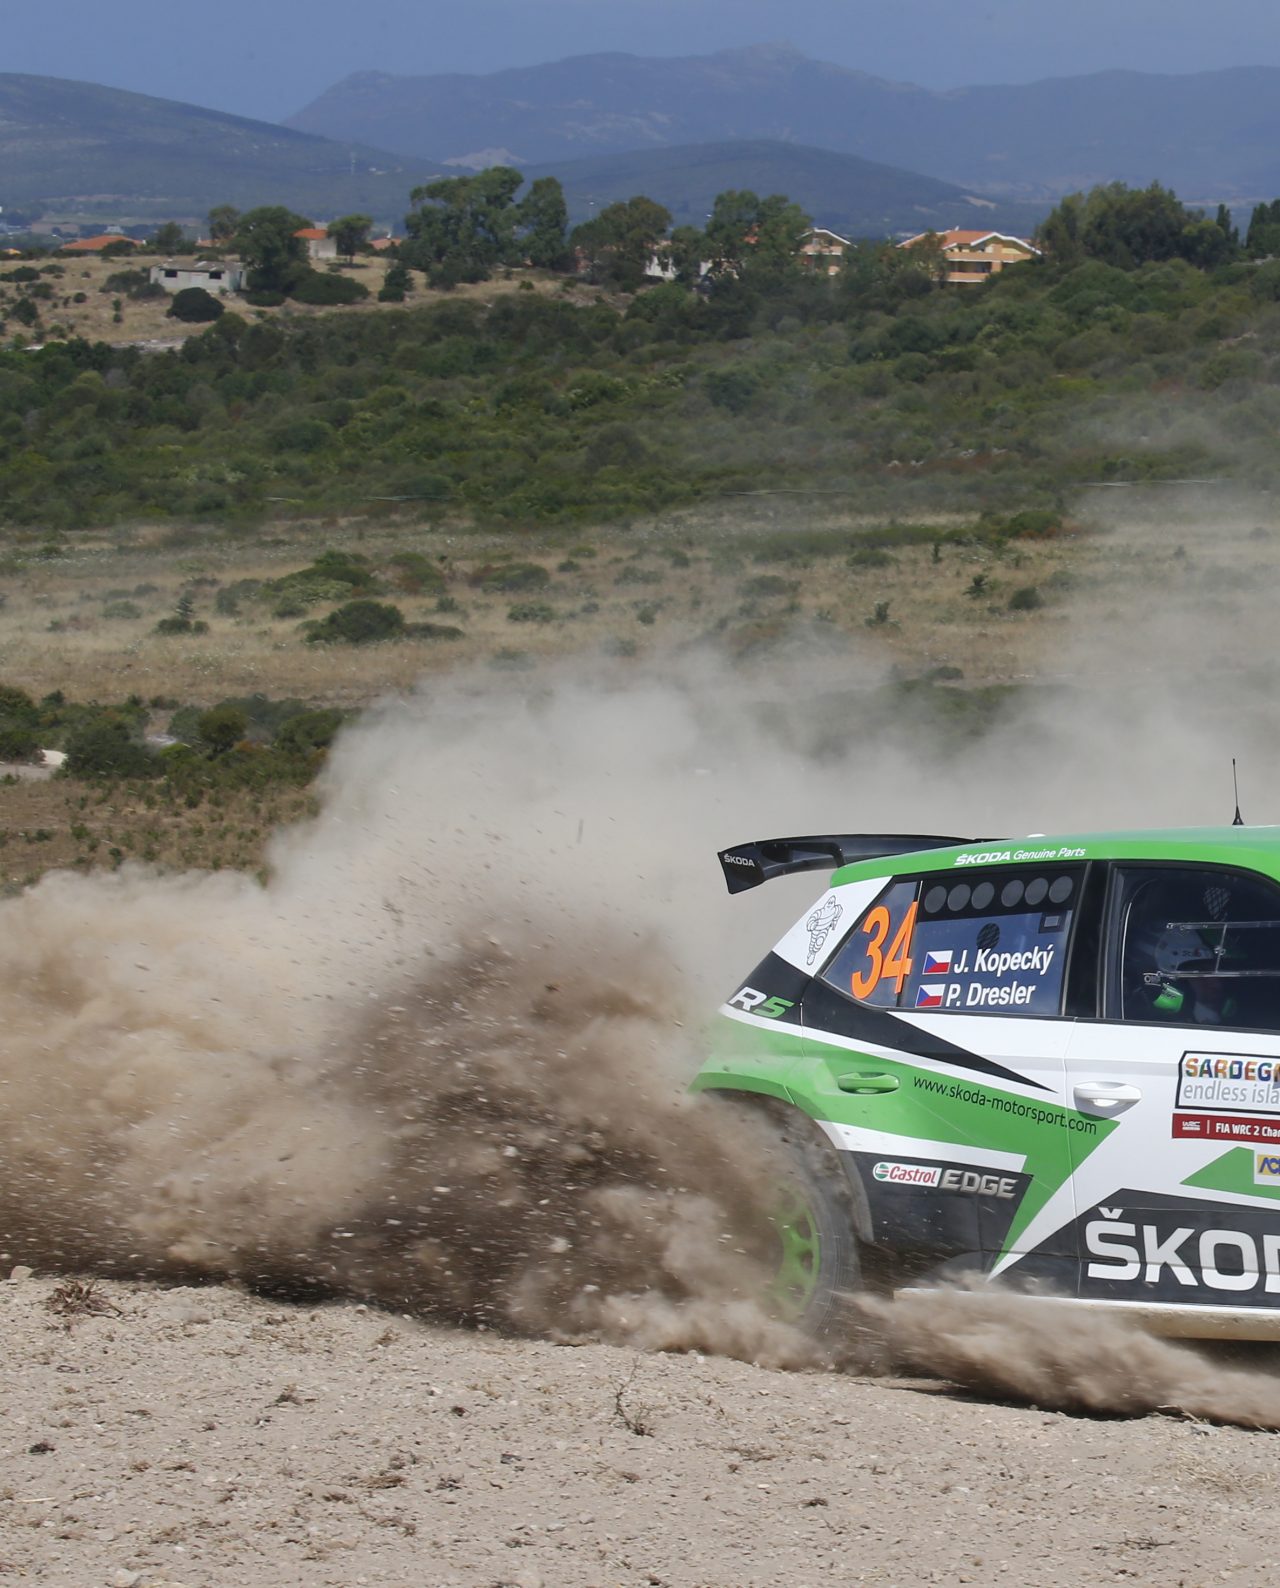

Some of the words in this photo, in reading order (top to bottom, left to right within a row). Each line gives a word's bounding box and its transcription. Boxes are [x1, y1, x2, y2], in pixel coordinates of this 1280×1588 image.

[954, 852, 1011, 866] ŠKODA
[1013, 849, 1056, 860] Genuine
[1057, 847, 1087, 858] Parts
[851, 901, 919, 1000] 34
[954, 949, 969, 974] J.
[974, 944, 1055, 977] Kopecký
[728, 985, 797, 1019] R5
[945, 983, 961, 1007] P.
[966, 981, 1036, 1006] Dresler
[914, 1075, 1097, 1135] www.skoda-motorsport.com
[1184, 1080, 1247, 1103] endless
[1216, 1122, 1230, 1133] FIA
[1232, 1123, 1251, 1135] WRC
[1253, 1125, 1260, 1135] 2
[889, 1165, 937, 1184] Castrol
[939, 1169, 1019, 1199] EDGE
